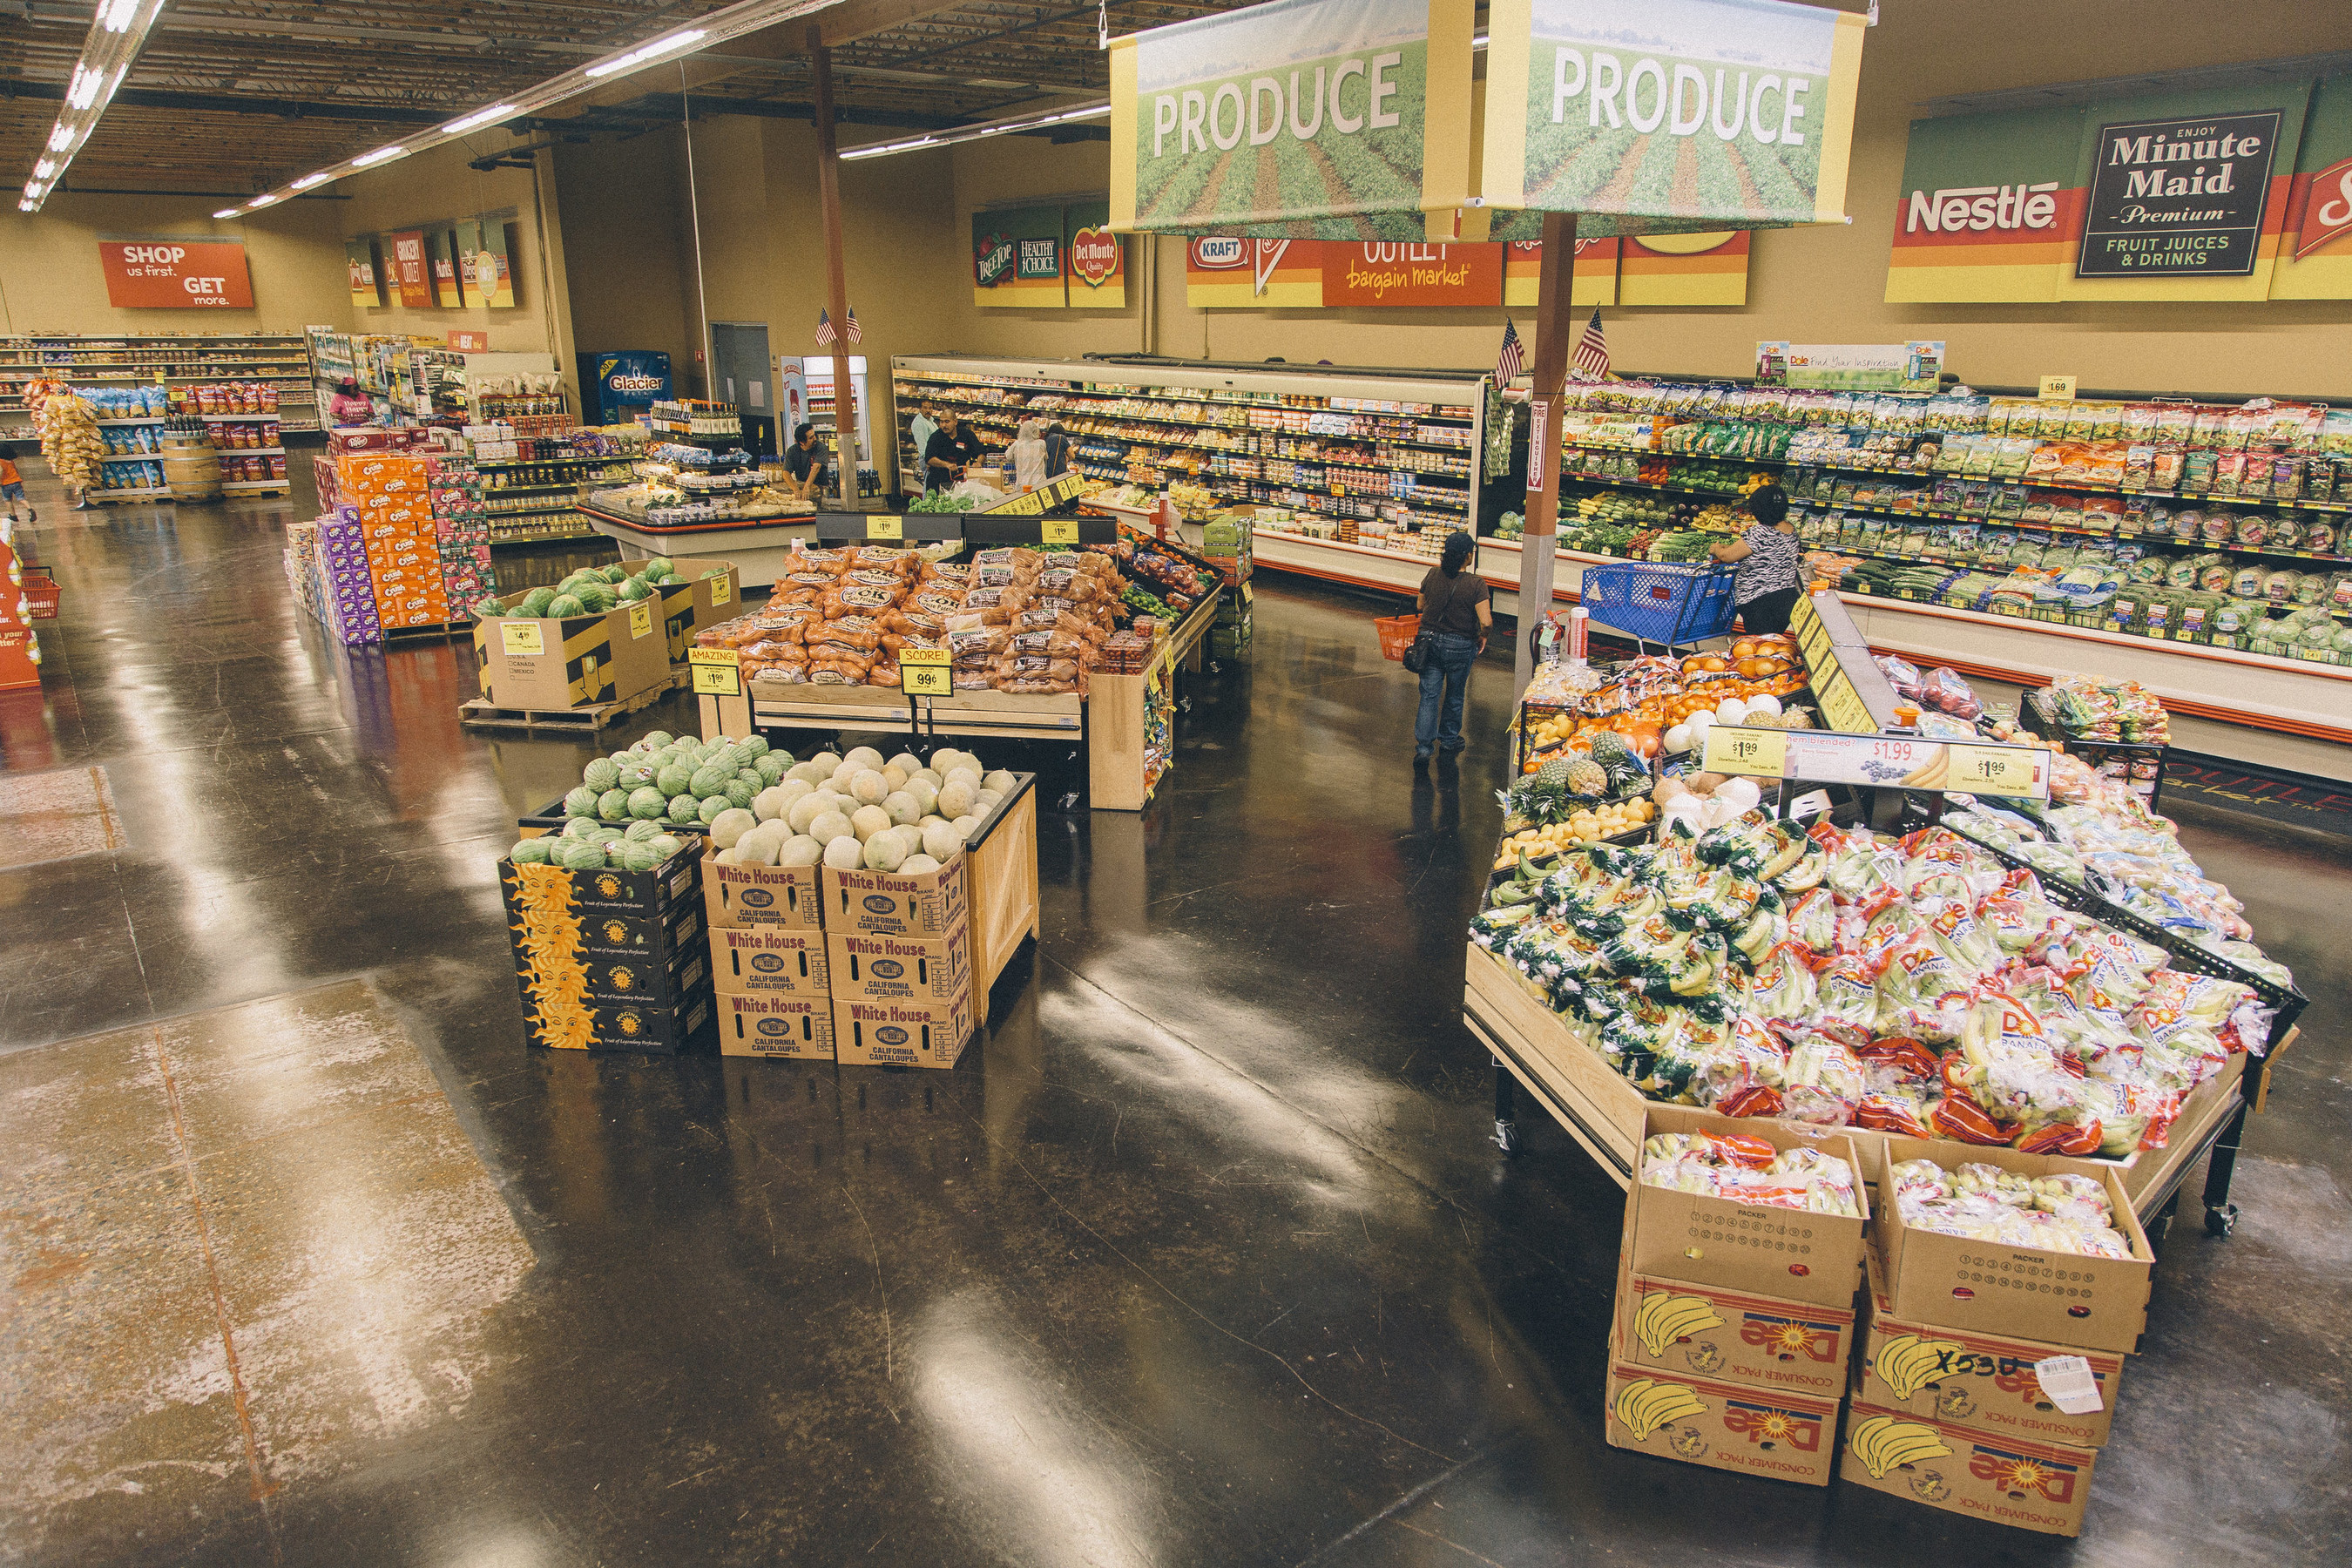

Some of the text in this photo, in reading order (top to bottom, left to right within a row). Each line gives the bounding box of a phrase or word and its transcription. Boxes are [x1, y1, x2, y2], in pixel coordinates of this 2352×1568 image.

[1551, 47, 1810, 146] PRODUCE
[1152, 51, 1402, 158] PRODUCE
[2177, 125, 2217, 138] ENJOY
[2108, 132, 2261, 166] Minute
[2123, 162, 2233, 199] Maid
[1907, 181, 2059, 233] Nestlé
[2119, 205, 2224, 225] Premium
[1021, 240, 1054, 258] HEALTHY
[1076, 243, 1114, 260] Del Monte
[1202, 240, 1239, 257] KRAFT
[2105, 236, 2230, 253] FRUIT JUICES
[123, 247, 186, 264] SHOP
[2121, 252, 2207, 266] & DRINKS
[127, 265, 177, 277] us first.
[1025, 257, 1055, 274] CHOICE
[1085, 260, 1104, 273] Quality
[184, 277, 226, 294] GET
[1346, 259, 1470, 299] bargain market
[1790, 355, 1809, 366] Dole
[1829, 356, 1850, 368] Your
[610, 375, 664, 391] Glacier
[1534, 409, 1545, 418] FIRE
[362, 462, 384, 476] Crush
[384, 479, 407, 493] Crush
[368, 494, 391, 509] Crush
[440, 490, 463, 504] Crush
[373, 524, 395, 538] Crush
[455, 578, 476, 591] Crush
[409, 611, 430, 625] Crush
[692, 651, 735, 661] AMAZING!
[905, 650, 944, 661] SCORE!
[917, 673, 937, 686] 99¢
[1787, 734, 1856, 747] hem blended?
[1874, 741, 1912, 761] $1.99
[2161, 777, 2281, 805] arket
[594, 873, 621, 886] DULCINEA
[716, 865, 795, 884] White House
[837, 871, 875, 889] White
[875, 875, 918, 893] House
[740, 909, 781, 917] CALIFORNIA
[861, 915, 902, 925] CALIFORNIA
[602, 919, 628, 931] DULCINEA
[737, 916, 787, 925] CANTALOUPES
[857, 923, 907, 932] CANTALOUPES
[727, 932, 806, 949] White House
[846, 937, 882, 955] White
[885, 940, 926, 956] House
[608, 965, 634, 977] DULCINEA
[746, 981, 795, 990] CANTALOUPES
[749, 975, 790, 983] CALIFORNIA
[868, 981, 909, 990] CALIFORNIA
[864, 988, 914, 997] CANTALOUPES
[732, 997, 812, 1013] White House
[615, 1011, 641, 1024] DULCINEA
[851, 1004, 888, 1022] White
[890, 1006, 931, 1023] House
[752, 1044, 801, 1053] CANTALOUPES
[754, 1037, 796, 1046] CALIFORNIA
[868, 1053, 919, 1063] CANTALOUPES
[872, 1046, 915, 1056] CALIFORNIA
[1738, 1209, 1767, 1220] PACKER
[2012, 1254, 2045, 1264] PACKER
[1732, 1363, 1759, 1375] PACK
[1762, 1366, 1834, 1387] CONSUMER
[1984, 1411, 2095, 1437] CONSUMER PACK
[1716, 1450, 1744, 1464] PACK
[1745, 1456, 1815, 1477] CONSUMER
[1959, 1497, 2067, 1528] CONSUMER PACK
